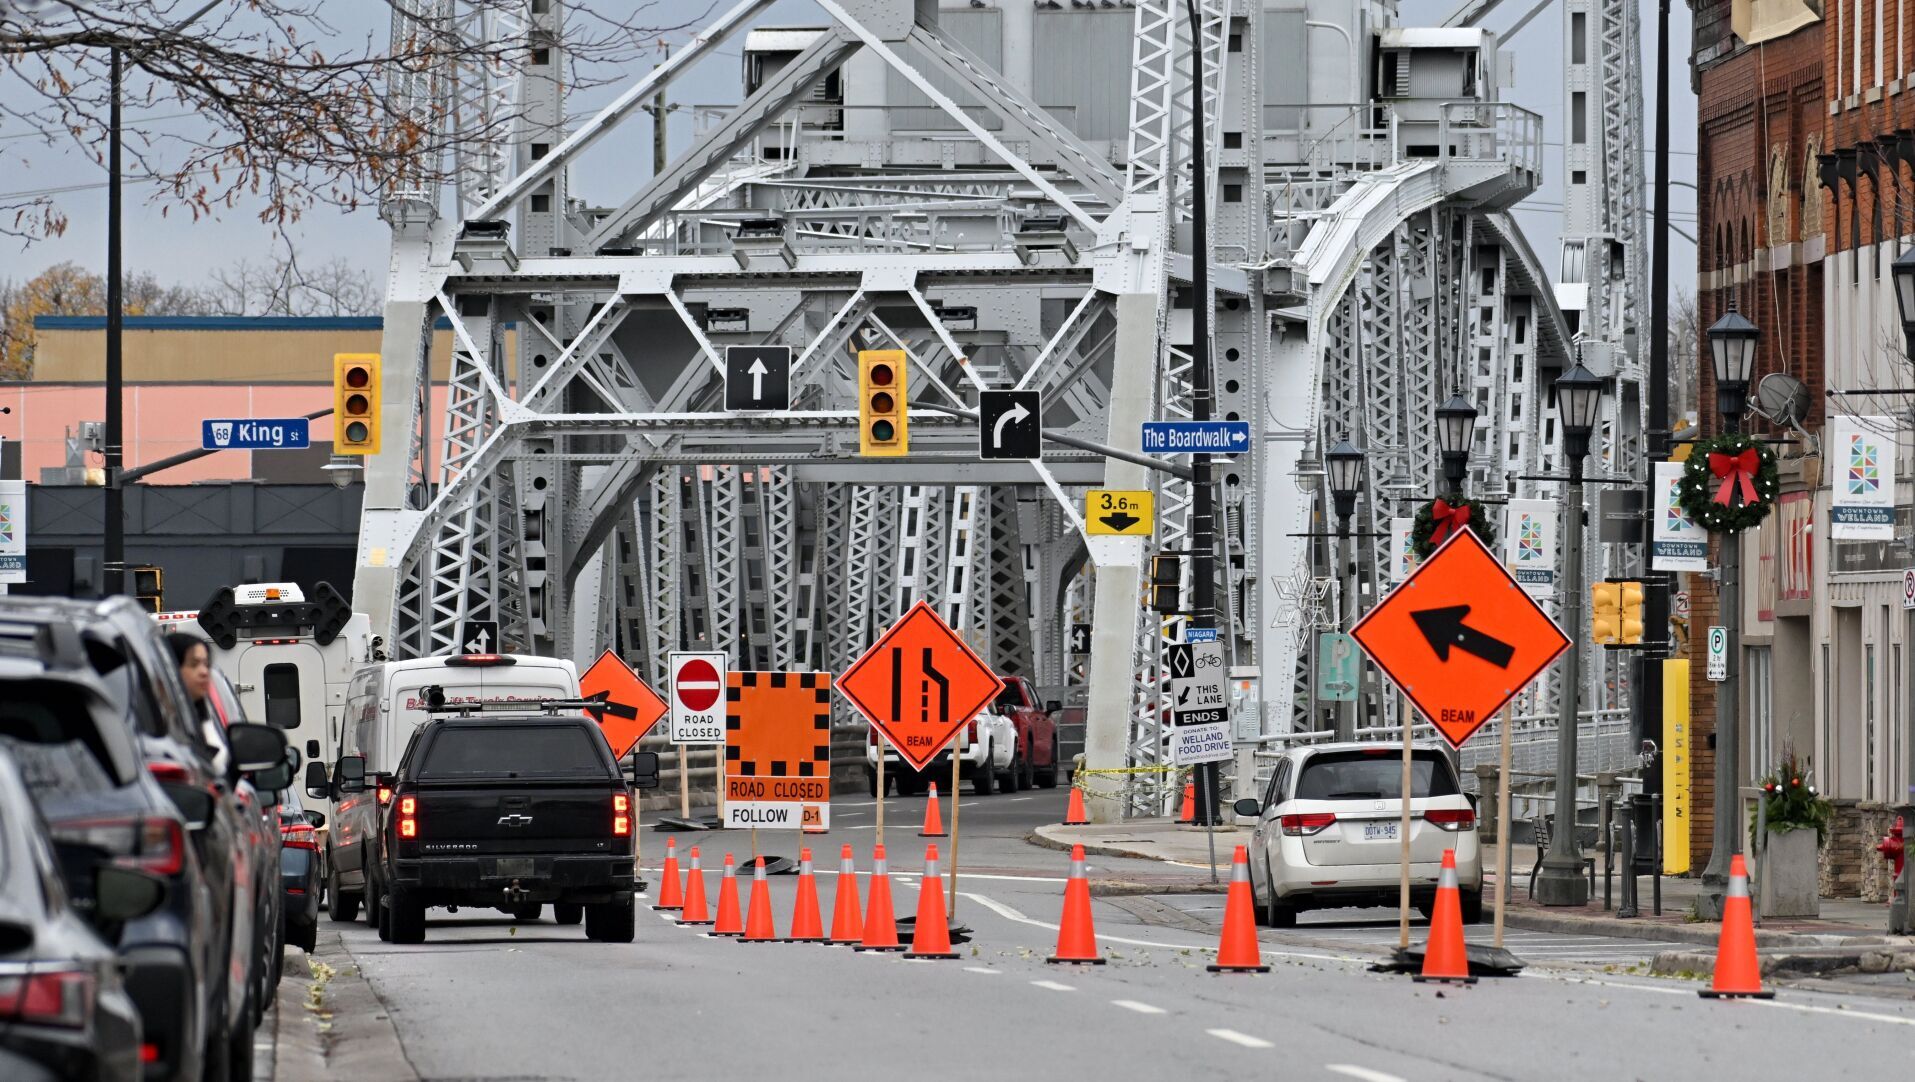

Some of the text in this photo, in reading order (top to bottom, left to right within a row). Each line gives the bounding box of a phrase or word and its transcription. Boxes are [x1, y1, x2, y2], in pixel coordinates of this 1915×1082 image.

[216, 428, 229, 440] 68
[240, 422, 283, 446] King
[1144, 427, 1231, 447] The Boardwalk
[1837, 513, 1889, 523] WELLAND
[1657, 547, 1703, 557] WELLAND
[1196, 684, 1219, 694] THIS
[1197, 694, 1222, 705] LANE
[684, 715, 714, 724] ROAD
[1183, 711, 1220, 723] ENDS
[1441, 709, 1475, 723] BEAM
[678, 728, 721, 737] CLOSED
[1182, 732, 1223, 745] WELLAND
[907, 735, 933, 746] BEAM
[1179, 741, 1230, 755] FOOD DRIVE
[731, 781, 824, 798] ROAD CLOSED
[732, 808, 820, 823] FOLLOW D-1
